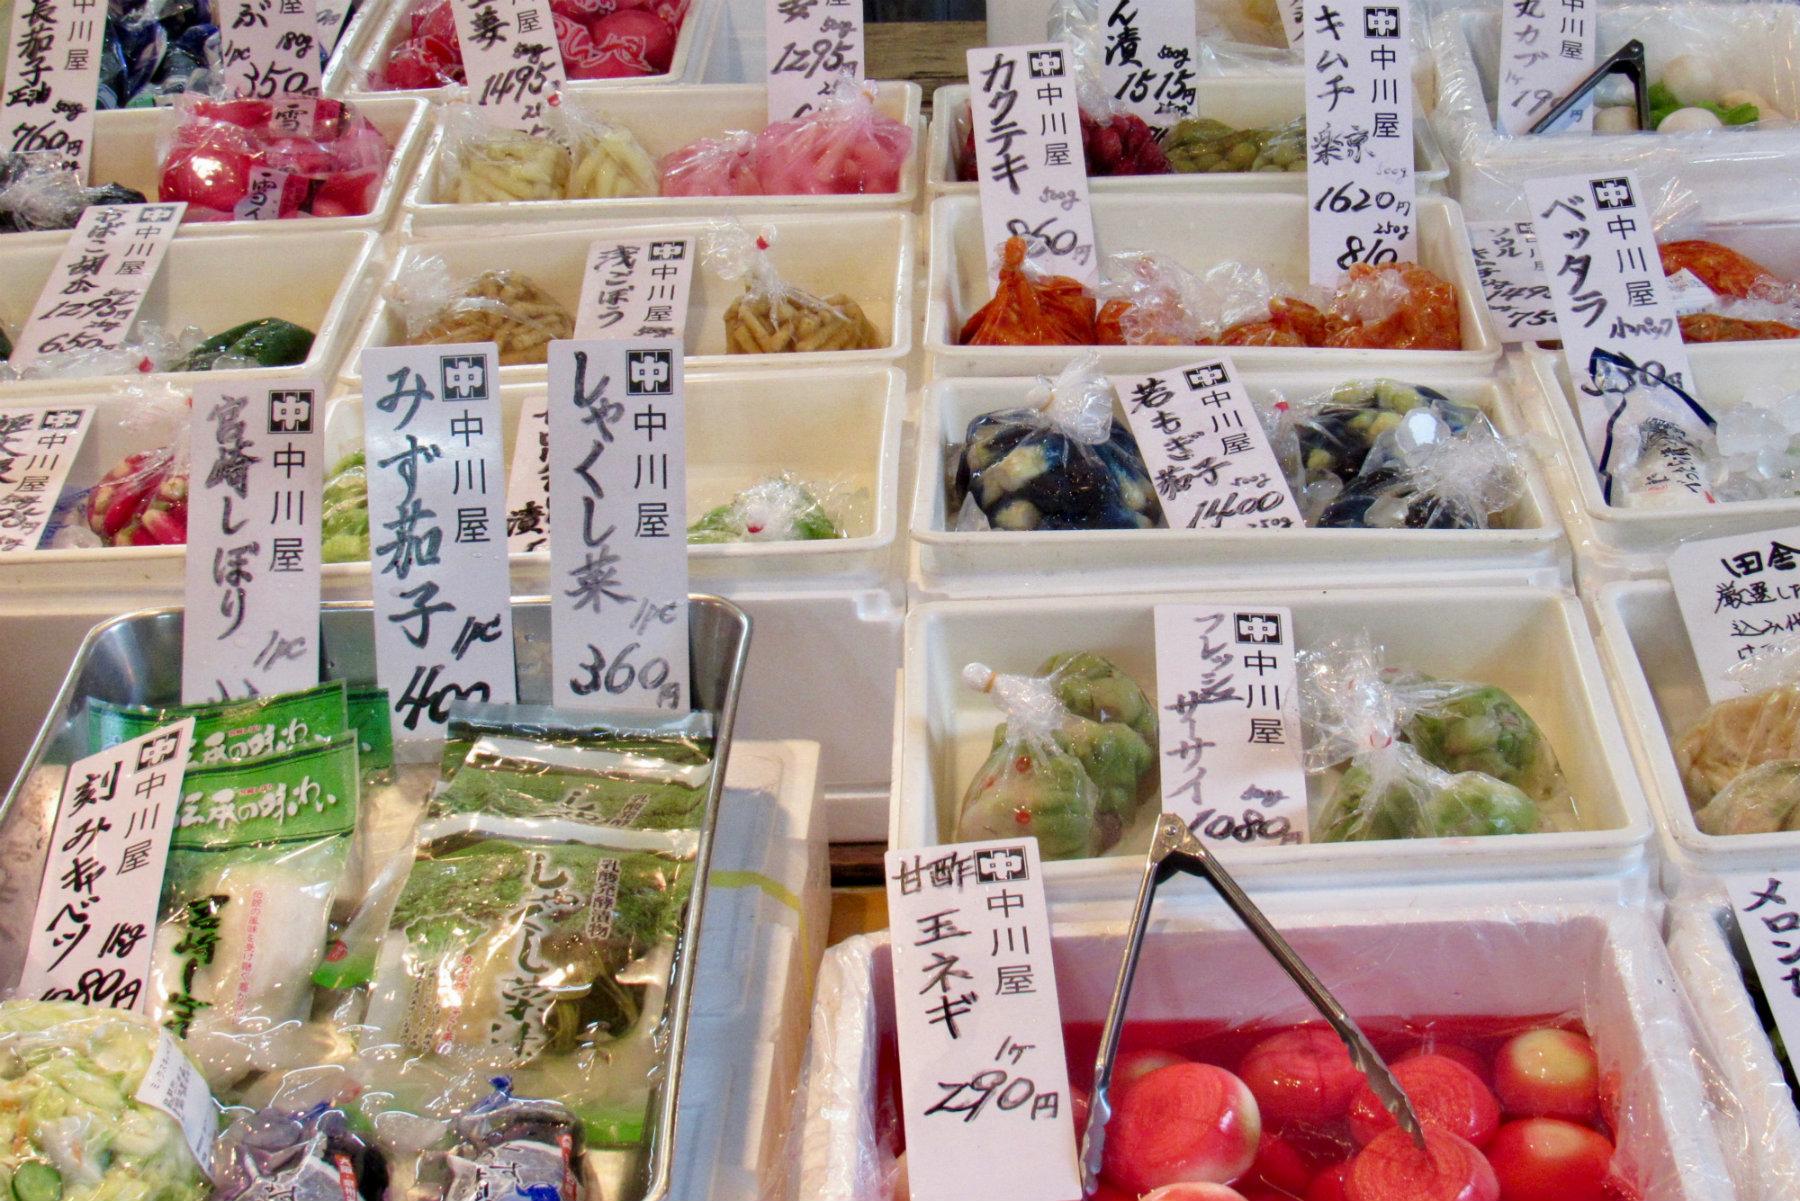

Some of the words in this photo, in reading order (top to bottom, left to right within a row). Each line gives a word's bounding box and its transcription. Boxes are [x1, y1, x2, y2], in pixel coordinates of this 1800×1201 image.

[64, 0, 95, 70] 中川屋
[1560, 0, 1585, 60] 中川屋
[980, 53, 1029, 195] カクテキ
[1037, 83, 1072, 166] 中川屋
[1370, 44, 1400, 138] 中川屋
[1313, 181, 1410, 217] 1620円
[1373, 222, 1410, 241] 250g
[115, 225, 161, 275] 中川屋
[643, 264, 677, 321] 中川屋
[1607, 214, 1658, 307] 中川屋
[14, 433, 67, 492] 中川屋
[1201, 390, 1255, 455] 中川屋
[270, 442, 306, 573] 中川屋
[376, 366, 457, 649] みず茄子
[450, 409, 491, 544] 中川屋
[565, 350, 636, 613] しゃくし菜
[633, 404, 671, 538] 中川屋
[569, 642, 681, 709] 360円
[1243, 650, 1286, 744] 中川屋
[116, 772, 167, 875] 中川屋
[893, 851, 976, 895] 甘酢
[914, 908, 978, 1039] 玉ネギ
[986, 888, 1036, 996] 中川屋
[924, 1070, 1058, 1122] 290円
